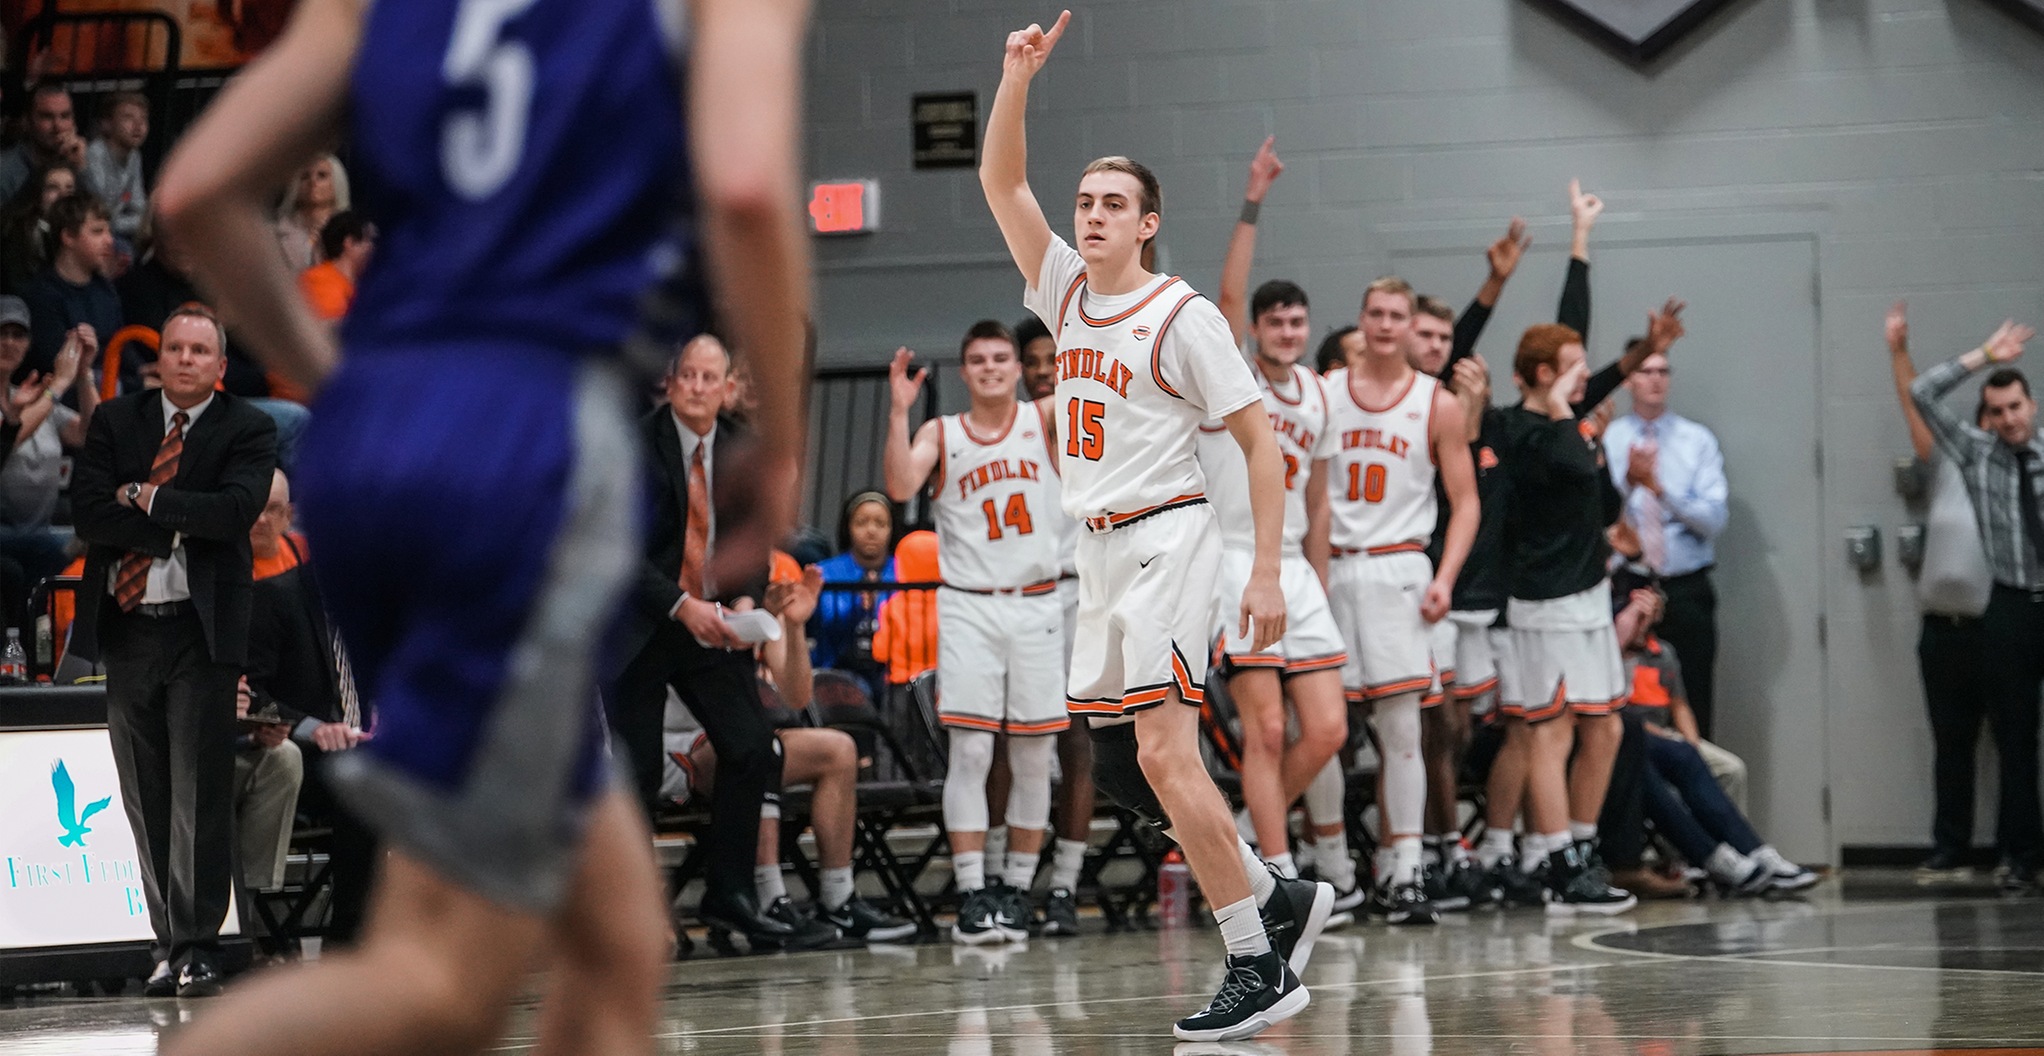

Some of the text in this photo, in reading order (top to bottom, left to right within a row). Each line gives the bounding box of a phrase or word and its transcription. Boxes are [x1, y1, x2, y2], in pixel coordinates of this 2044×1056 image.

[442, 0, 538, 200] 5
[1066, 396, 1106, 462] 15
[1341, 428, 1409, 460] INDLAY
[958, 458, 1040, 501] FINDLAY
[1281, 447, 1299, 490] 2
[1347, 462, 1387, 503] 10
[981, 490, 1034, 542] 14
[7, 856, 72, 888] FIRST
[124, 886, 144, 917] B
